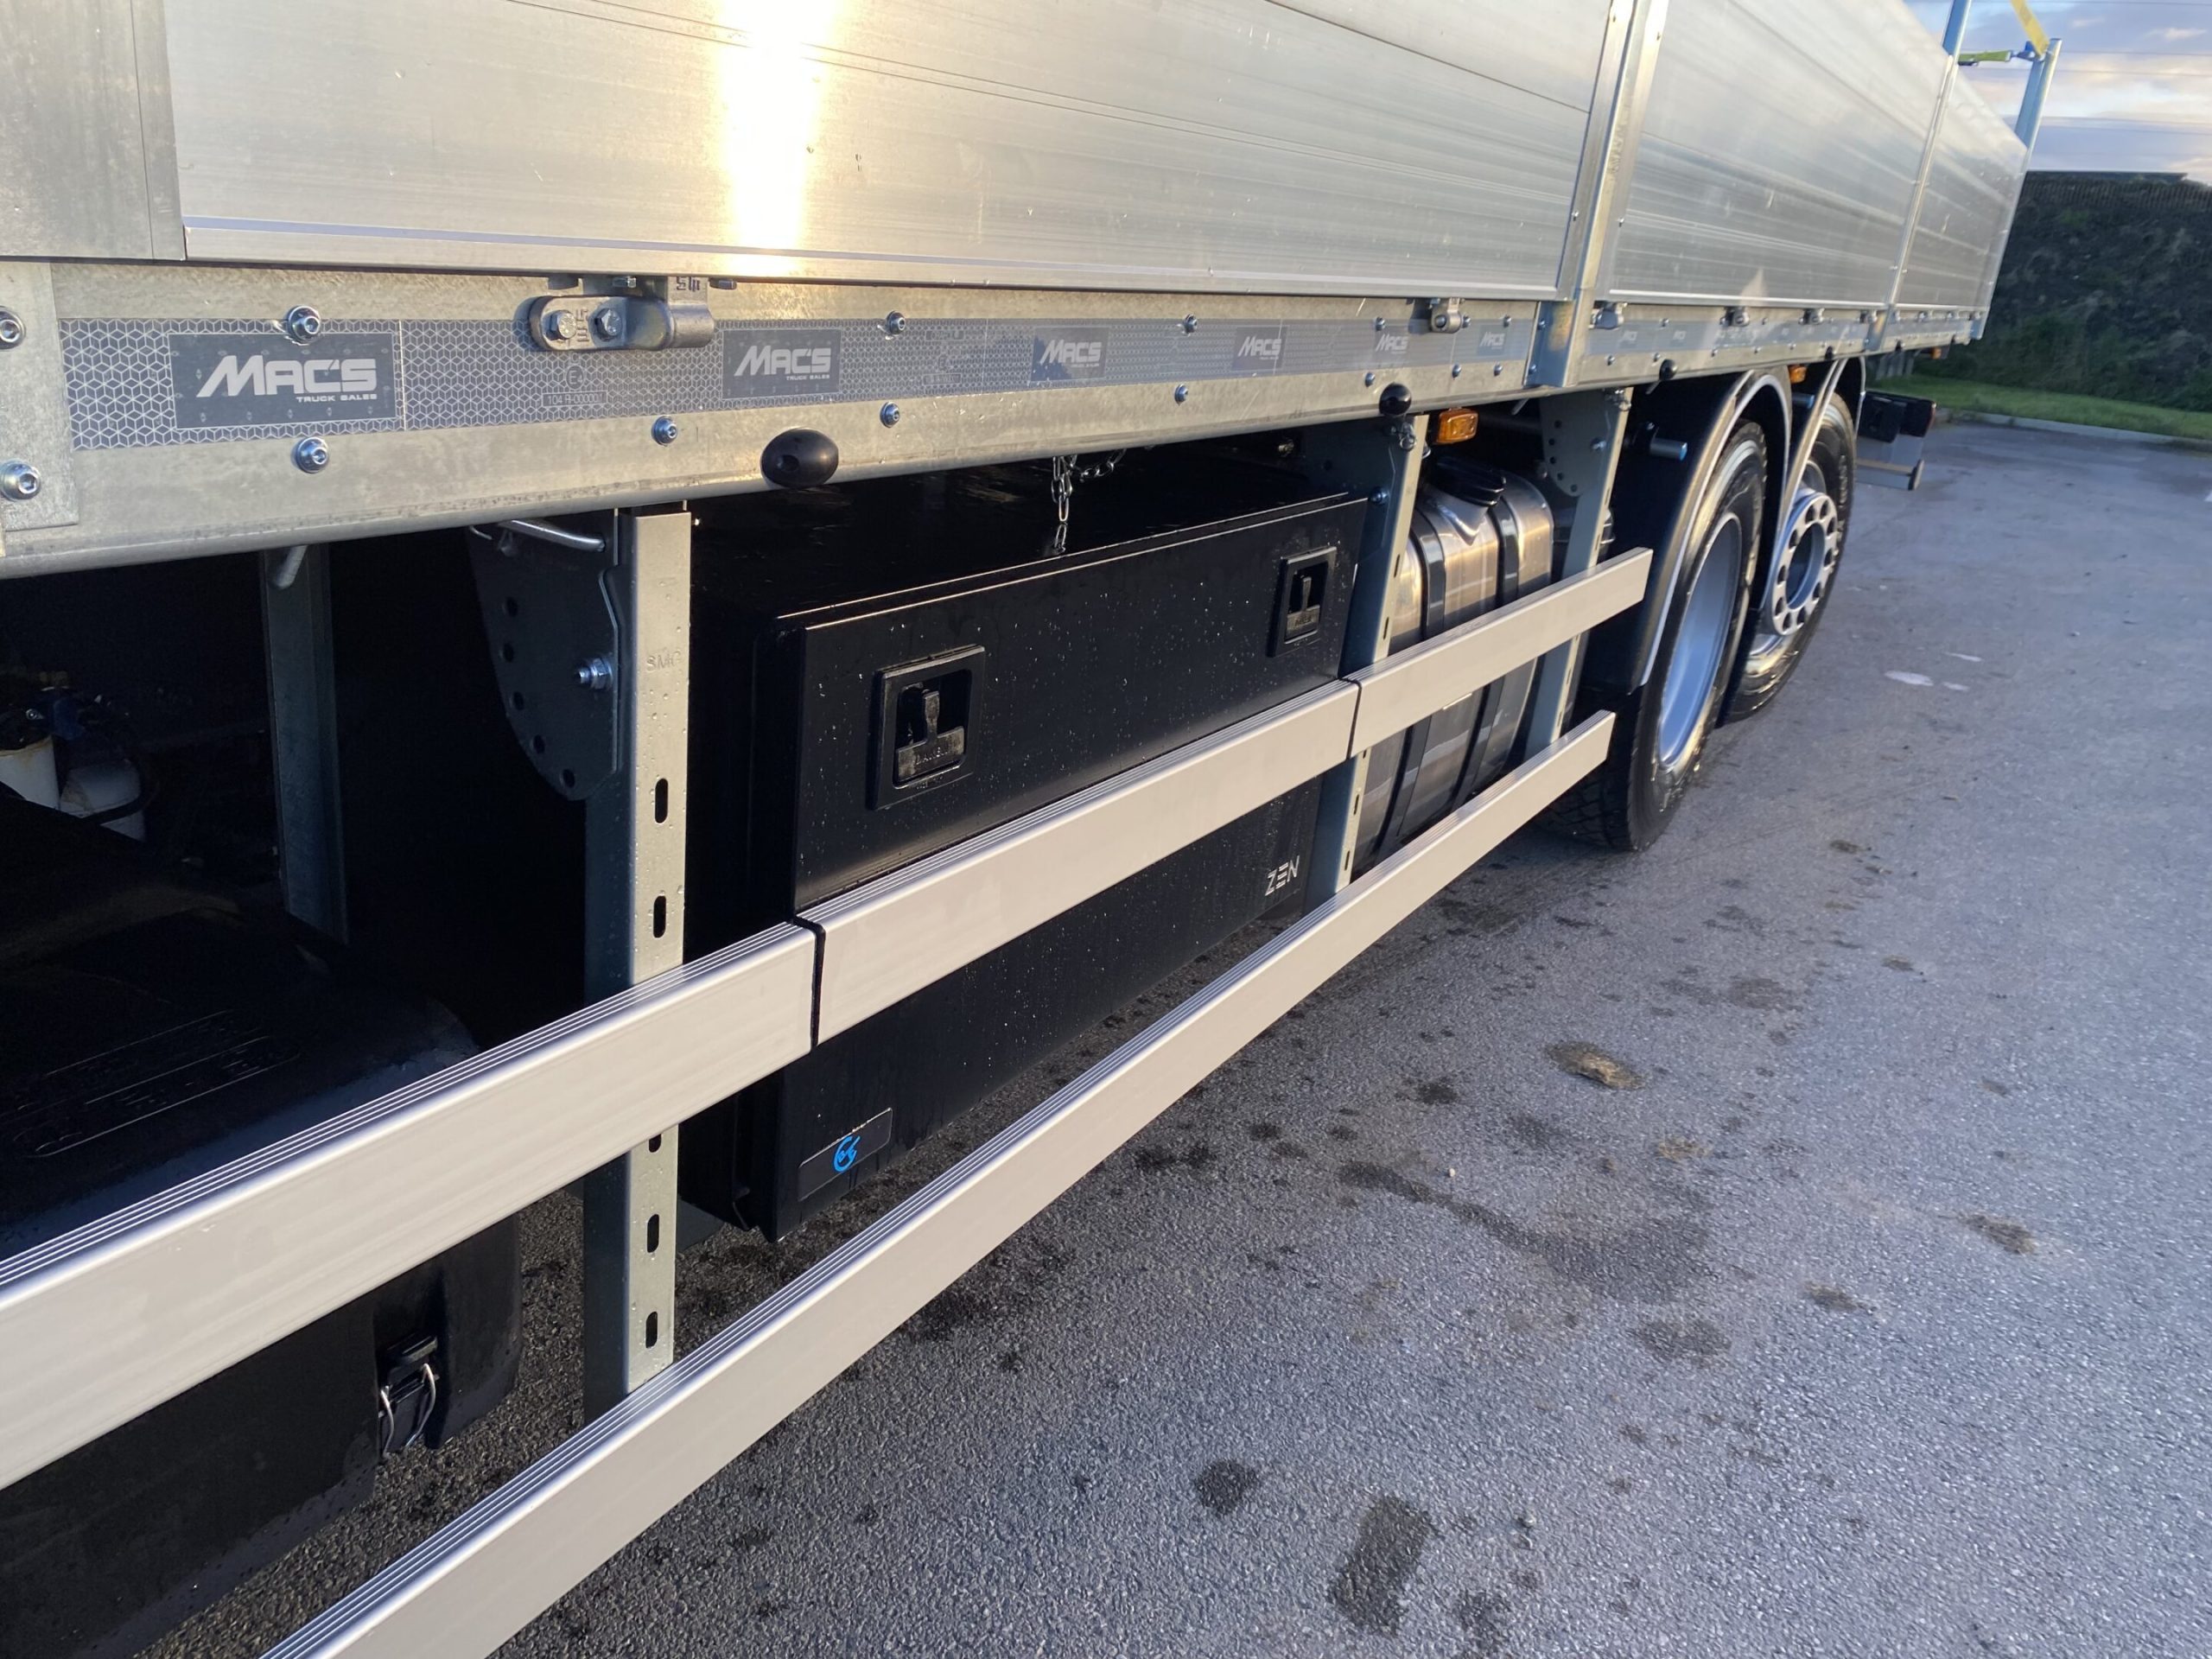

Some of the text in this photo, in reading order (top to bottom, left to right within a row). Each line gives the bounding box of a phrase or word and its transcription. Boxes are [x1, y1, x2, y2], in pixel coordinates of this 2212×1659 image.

[296, 395, 336, 404] TRUCK
[548, 394, 563, 406] 104
[1265, 855, 1300, 896] ZEN
